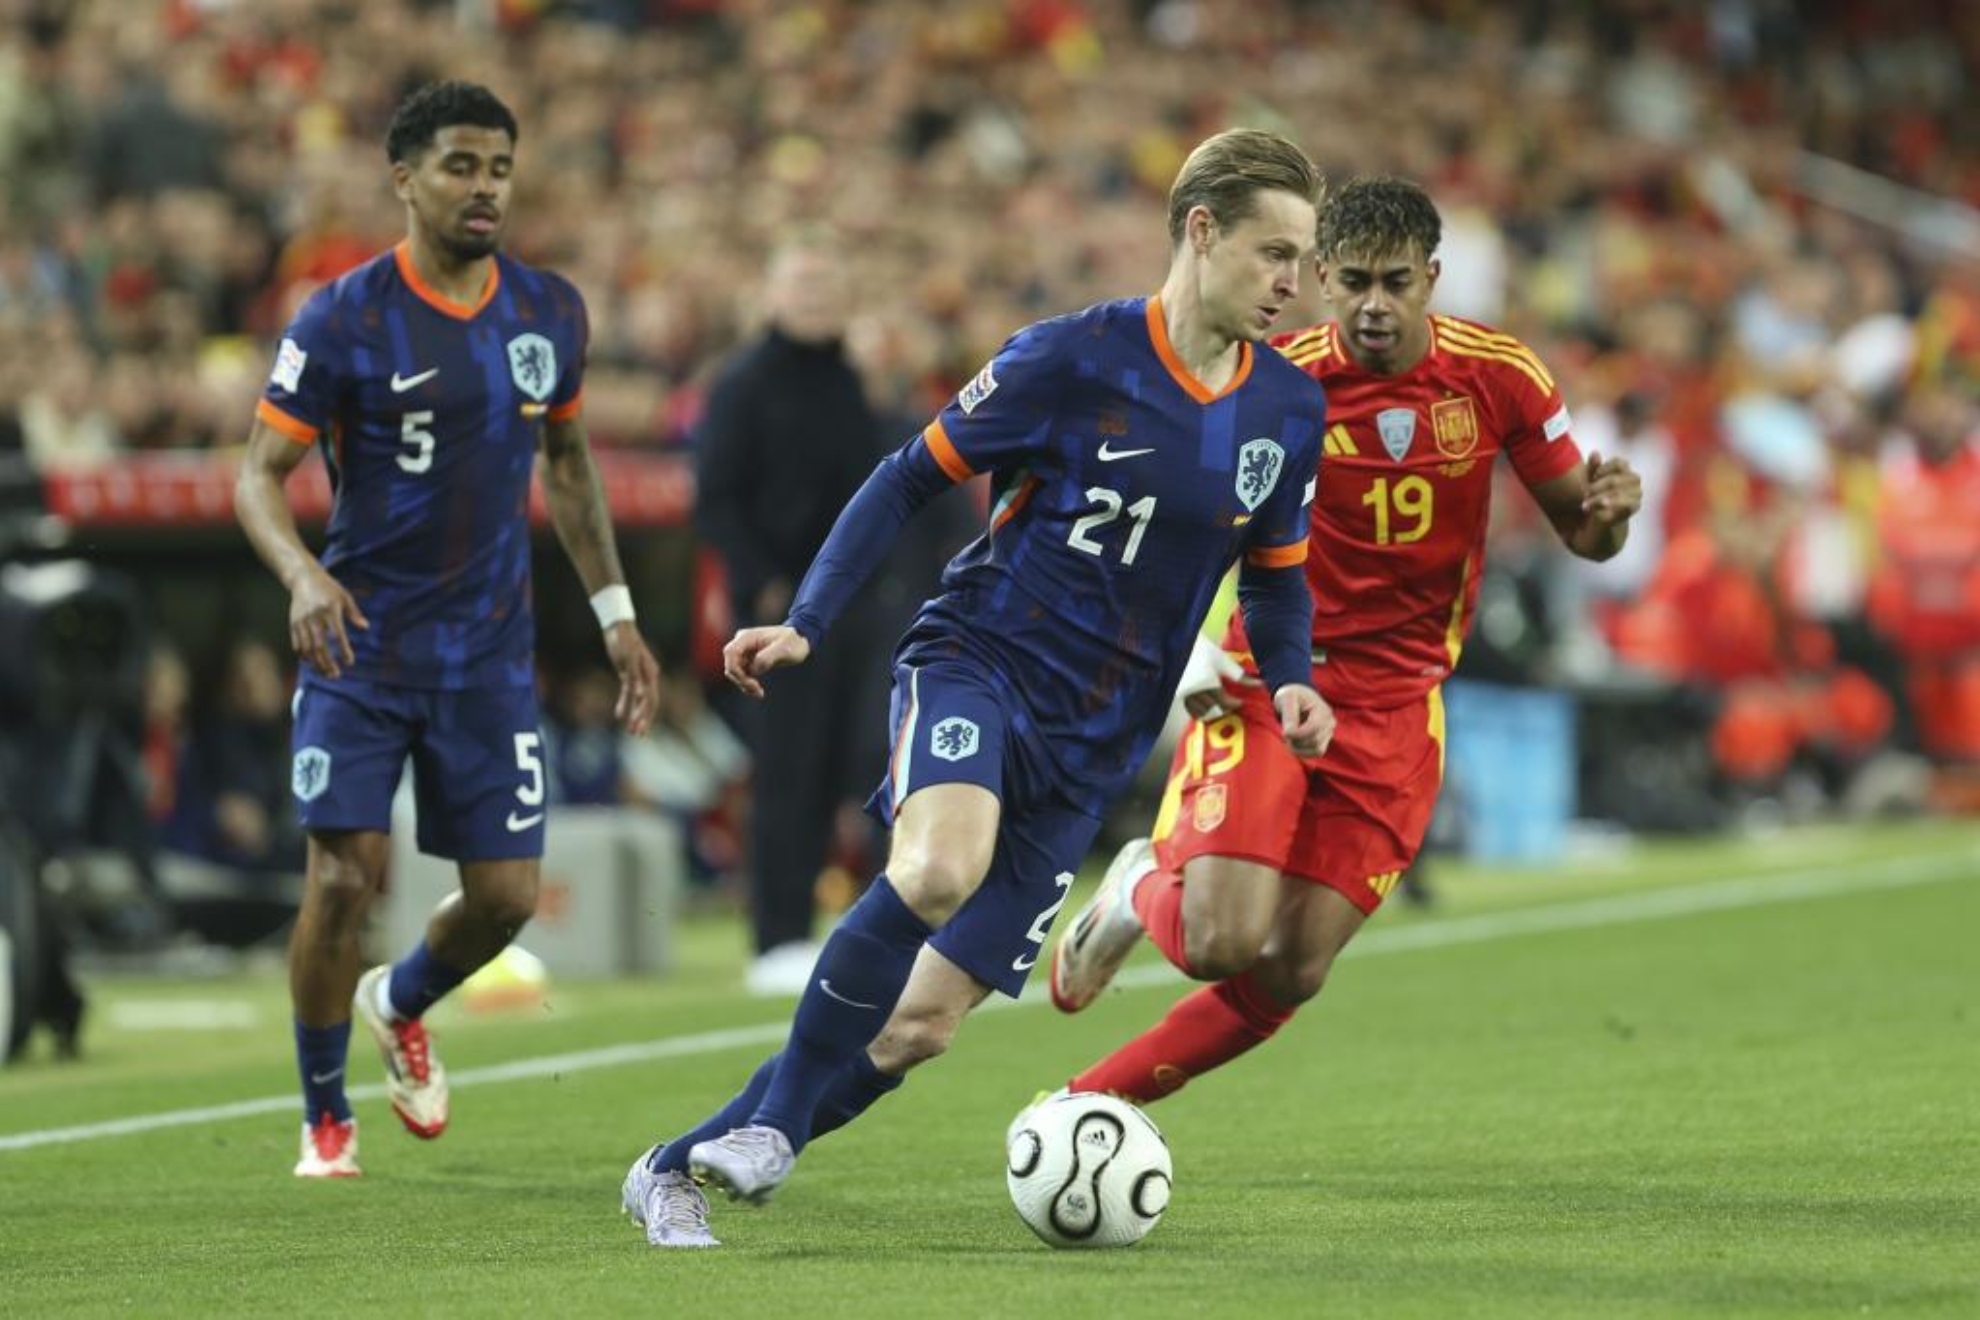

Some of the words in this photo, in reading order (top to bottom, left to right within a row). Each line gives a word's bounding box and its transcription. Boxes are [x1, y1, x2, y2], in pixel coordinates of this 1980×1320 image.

[396, 410, 436, 474] 5
[1067, 486, 1157, 565] 21
[1362, 475, 1434, 546] 19
[513, 732, 545, 806] 5
[1185, 712, 1245, 780] 19
